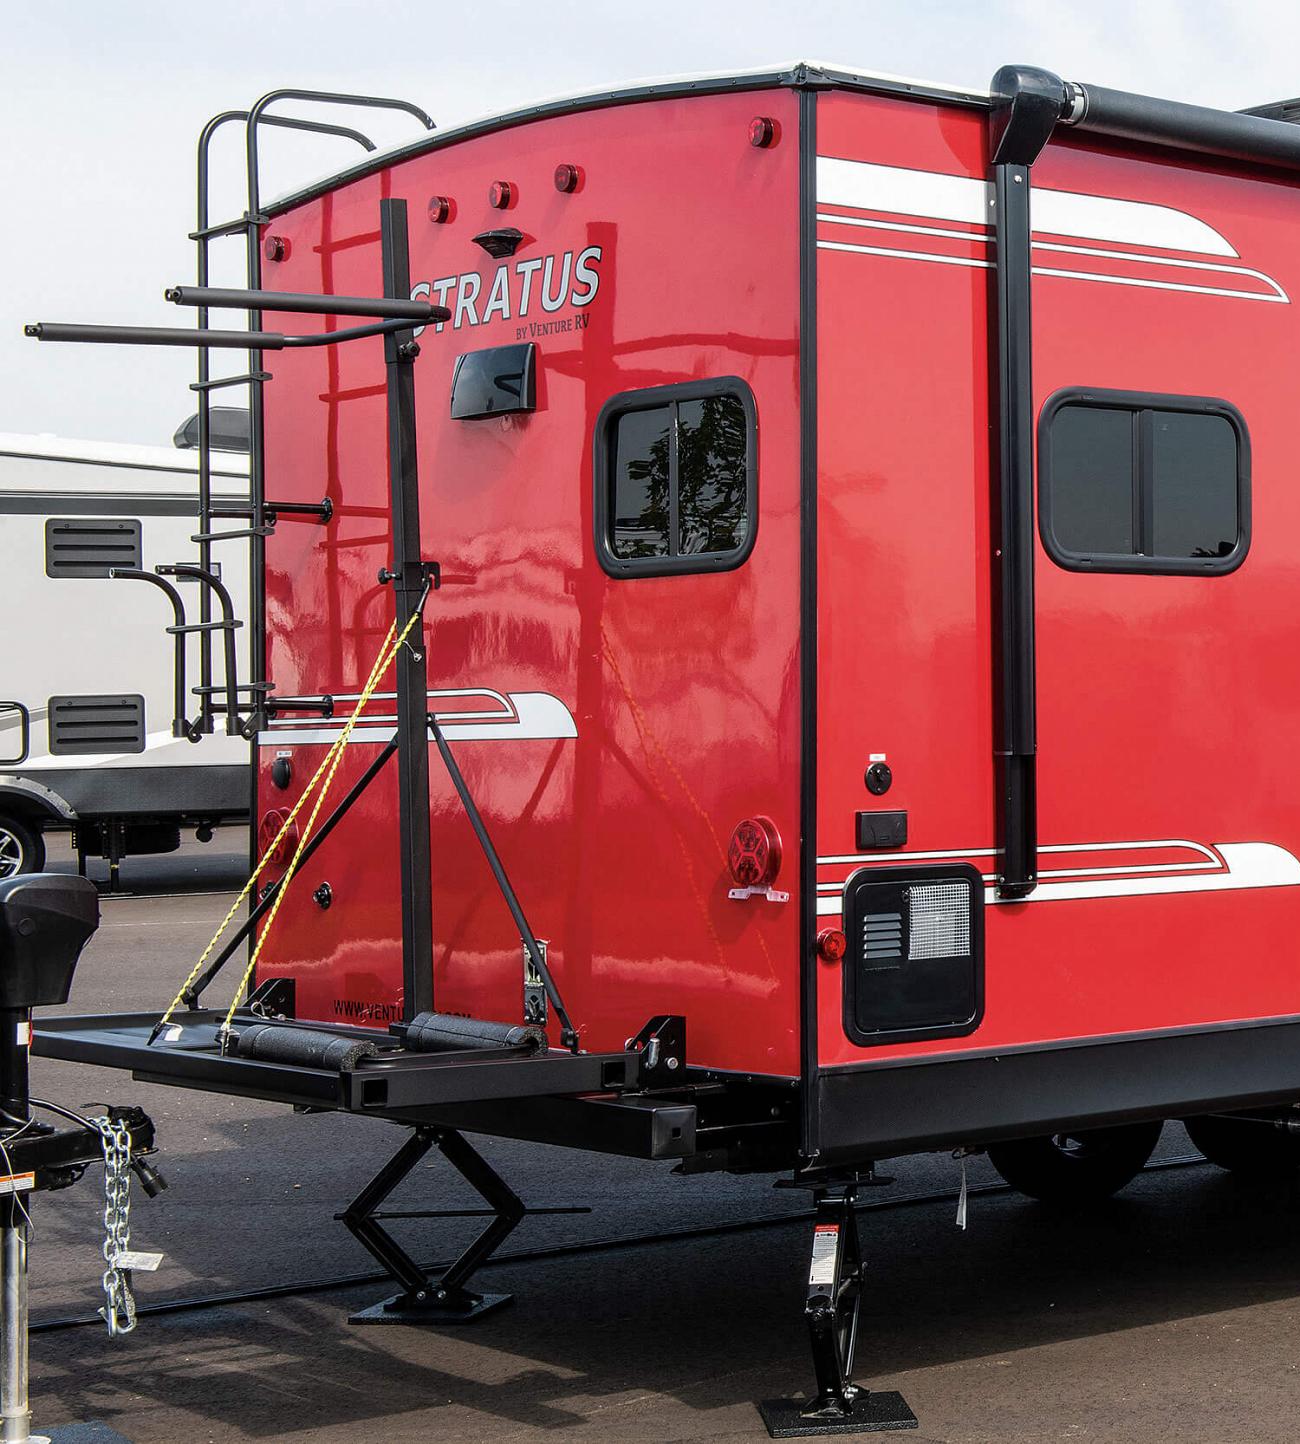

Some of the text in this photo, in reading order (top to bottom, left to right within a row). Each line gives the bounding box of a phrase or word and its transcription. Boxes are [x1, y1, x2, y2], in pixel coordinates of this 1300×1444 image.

[410, 246, 603, 338] STRATUS
[516, 313, 590, 340] BY VENTURE RV
